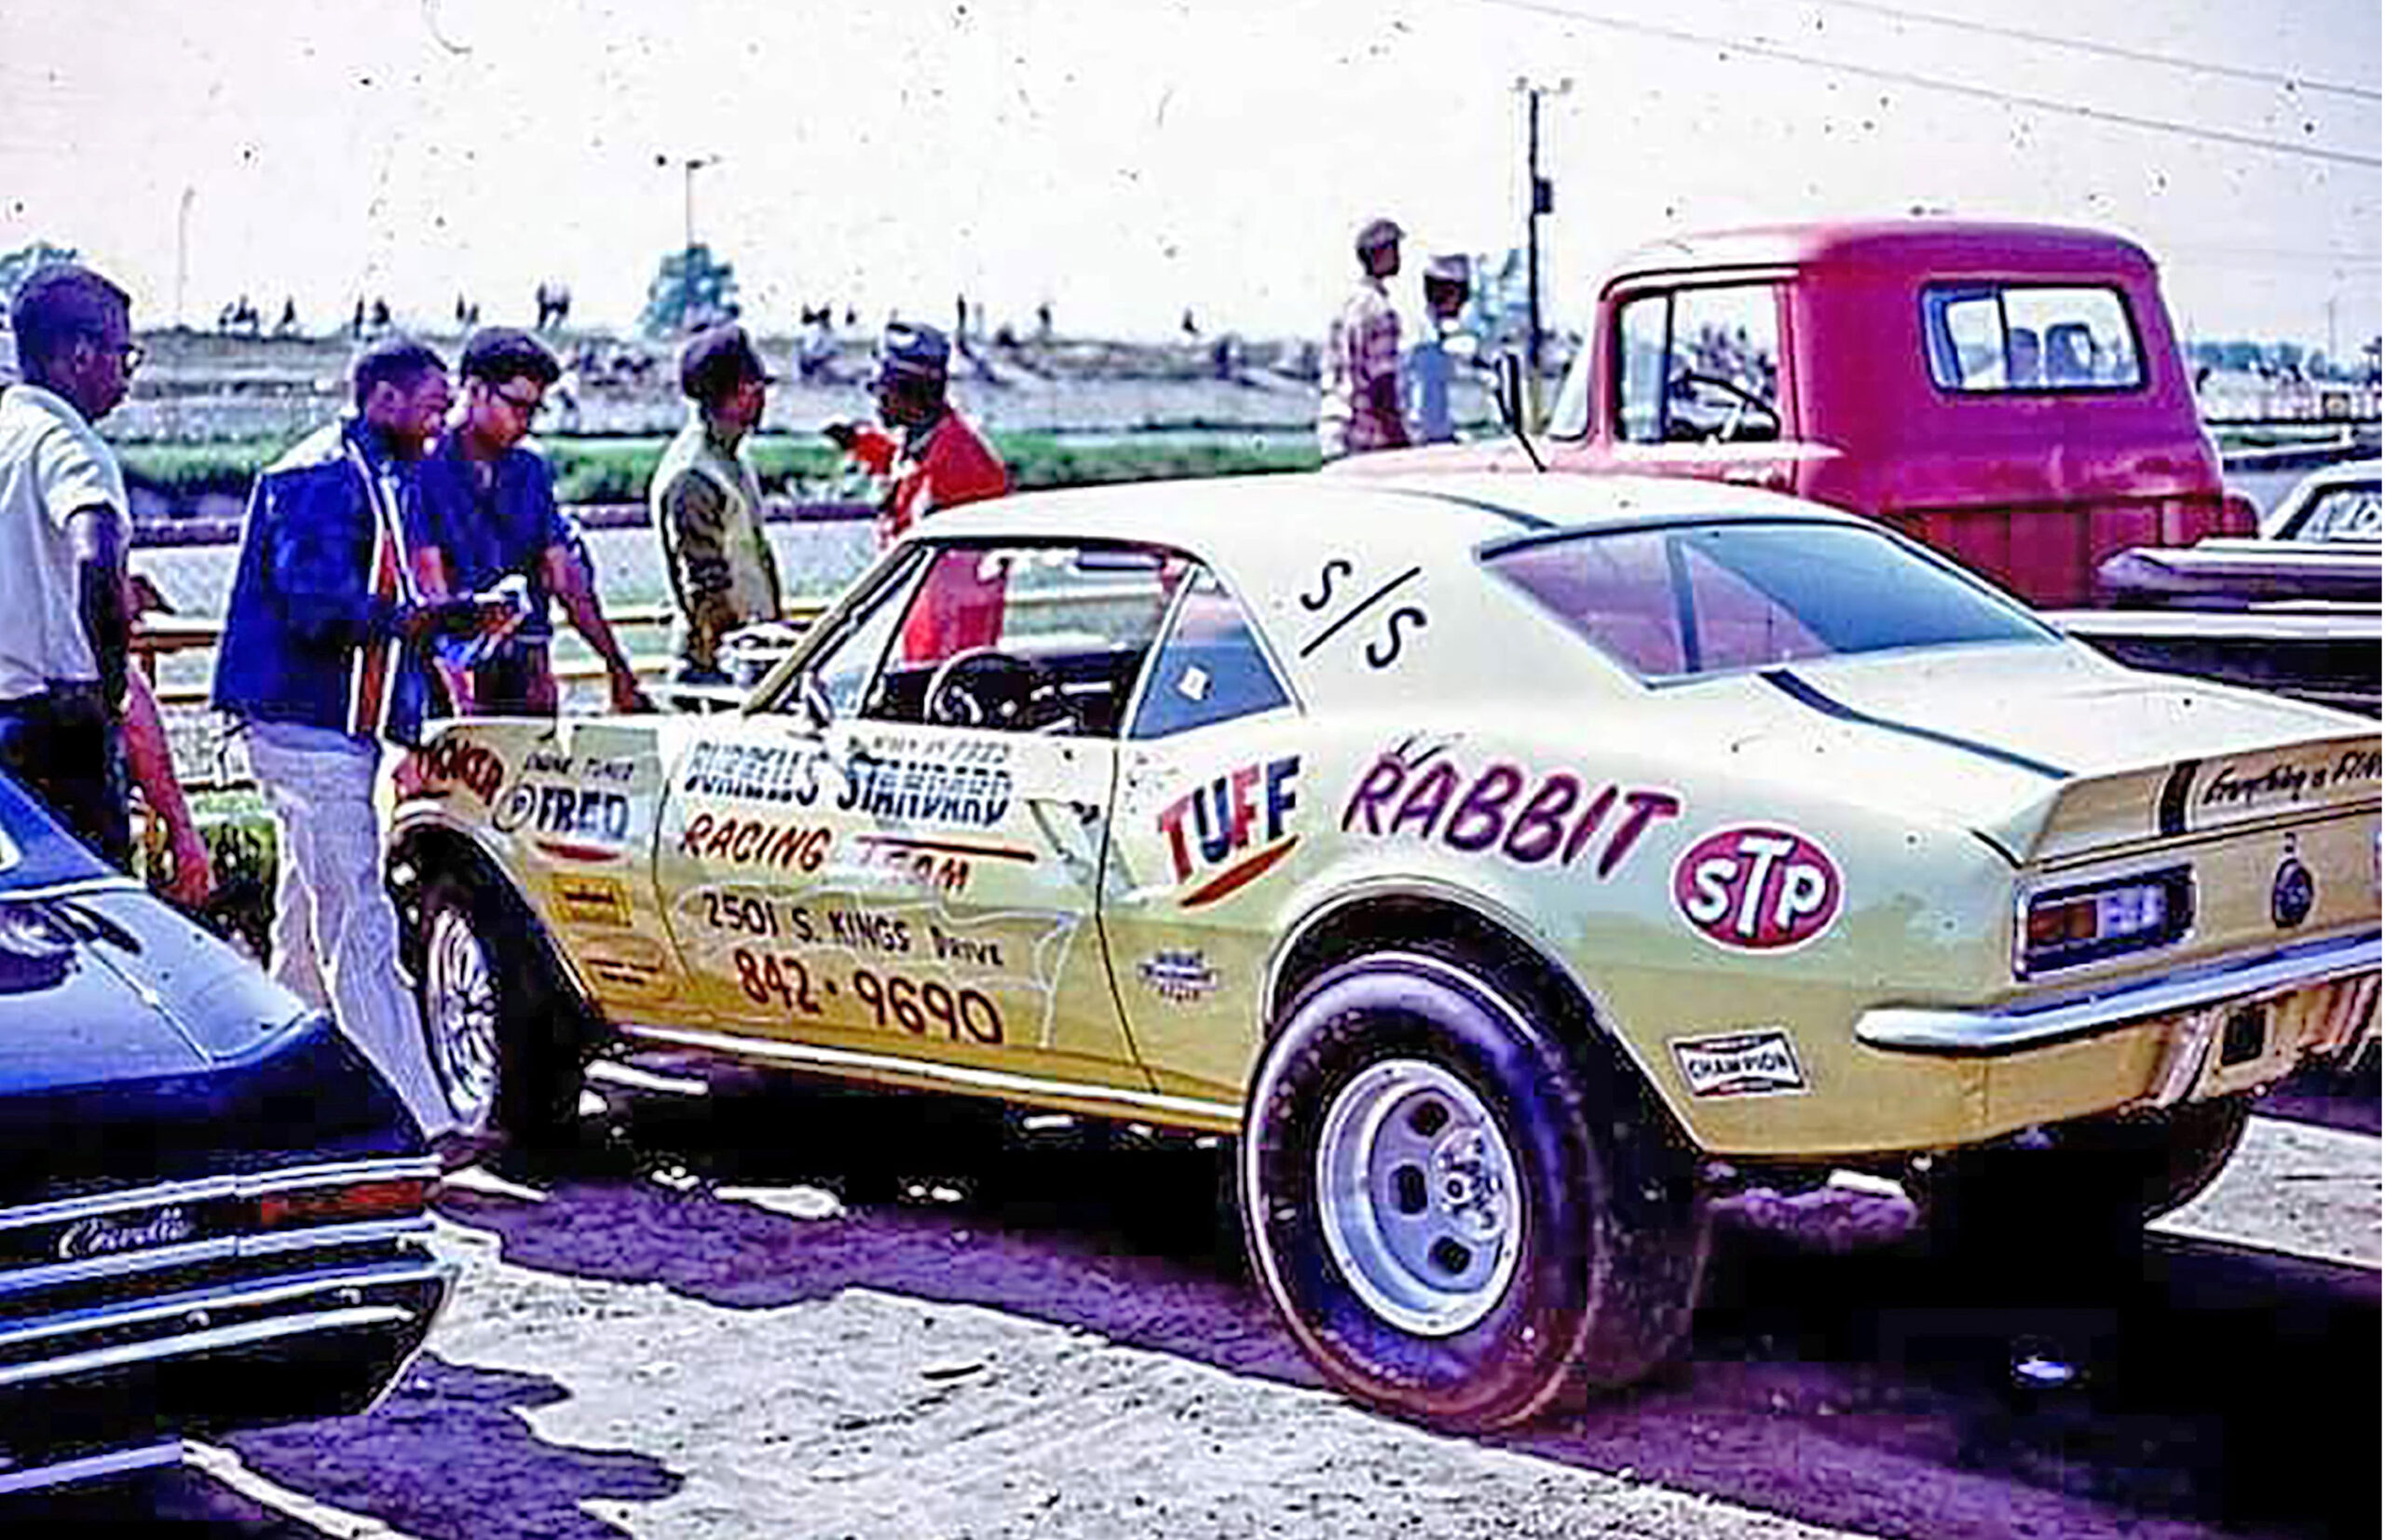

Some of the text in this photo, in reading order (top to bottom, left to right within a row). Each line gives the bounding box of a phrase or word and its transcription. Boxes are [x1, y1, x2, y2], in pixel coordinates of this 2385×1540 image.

[680, 812, 832, 872] RACING
[1158, 756, 1302, 883] TUFF
[1342, 751, 1680, 879] RABBIT
[702, 892, 780, 937] 2501
[828, 911, 911, 952] KINGS
[1686, 838, 1828, 939] STP
[1688, 1053, 1790, 1080] CHAMPION
